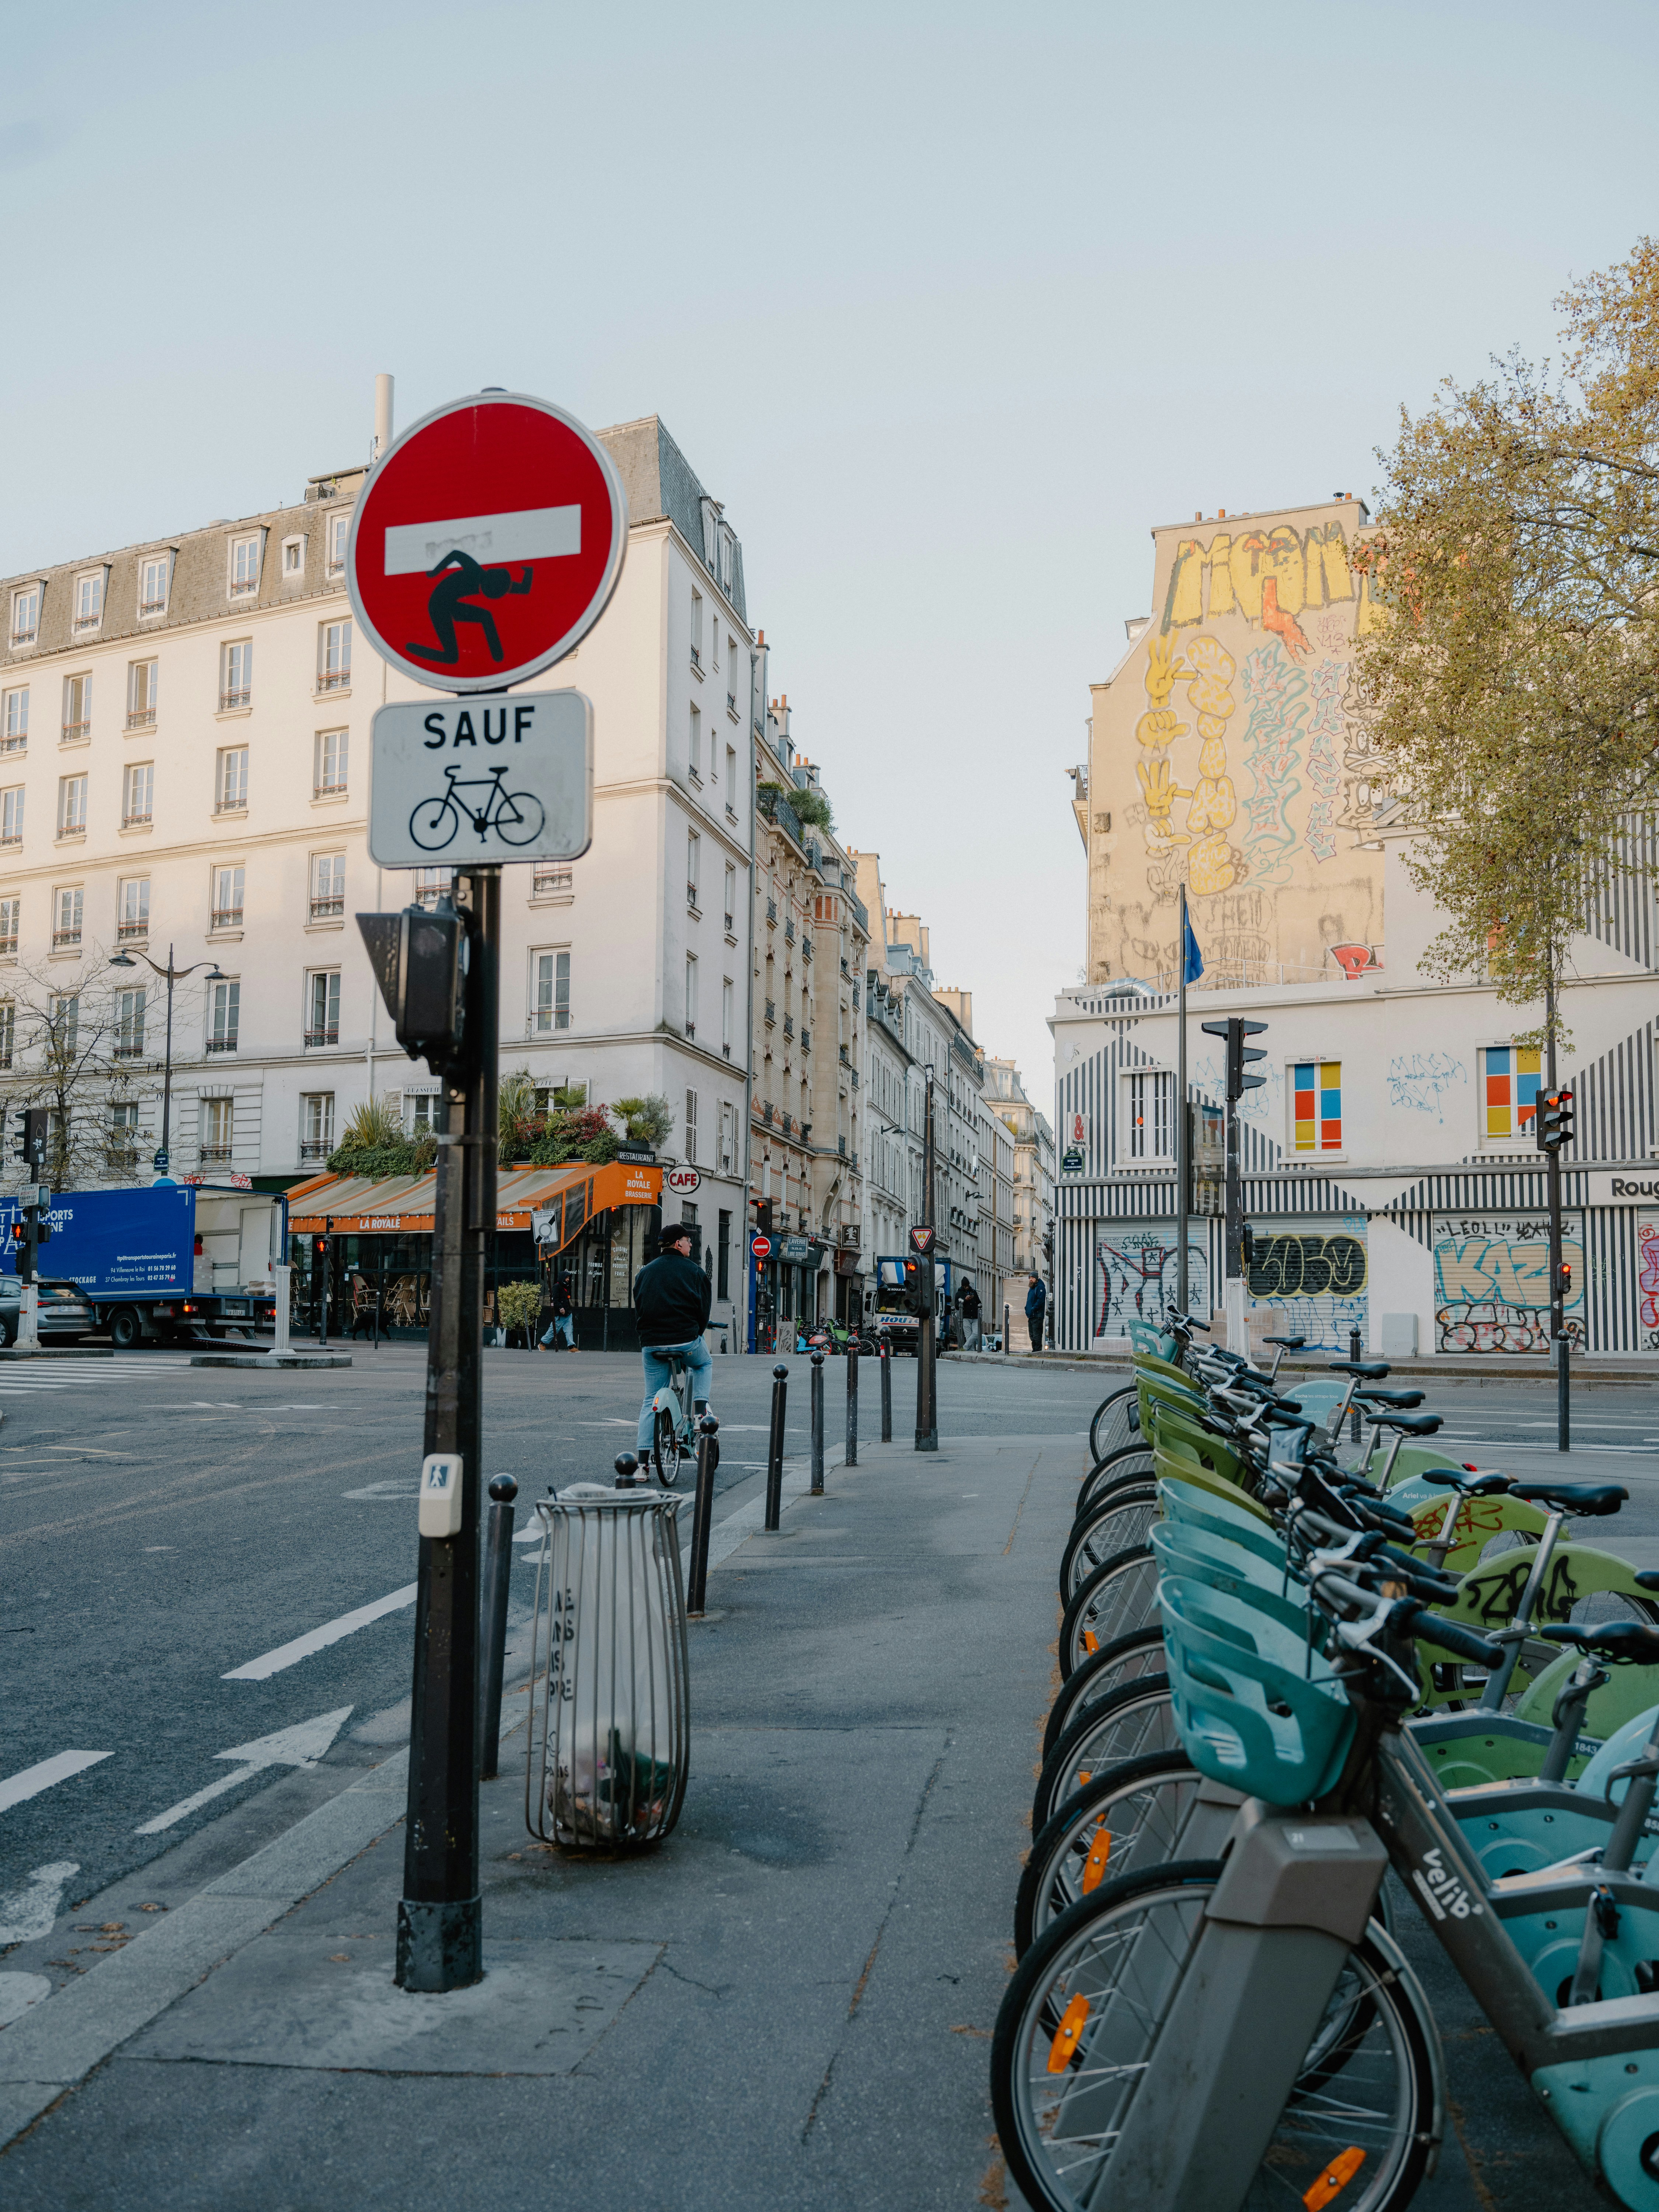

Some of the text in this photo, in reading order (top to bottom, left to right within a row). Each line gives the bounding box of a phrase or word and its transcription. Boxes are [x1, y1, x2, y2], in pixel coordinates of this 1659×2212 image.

[424, 706, 535, 749] SAUF
[619, 1152, 654, 1163] RESTAURANT
[635, 1171, 643, 1179] LA
[669, 1173, 696, 1186] CAFE
[627, 1180, 650, 1189] ROYALE
[625, 1190, 652, 1199] BRASSERIE
[360, 1219, 400, 1229] LA ROYALE
